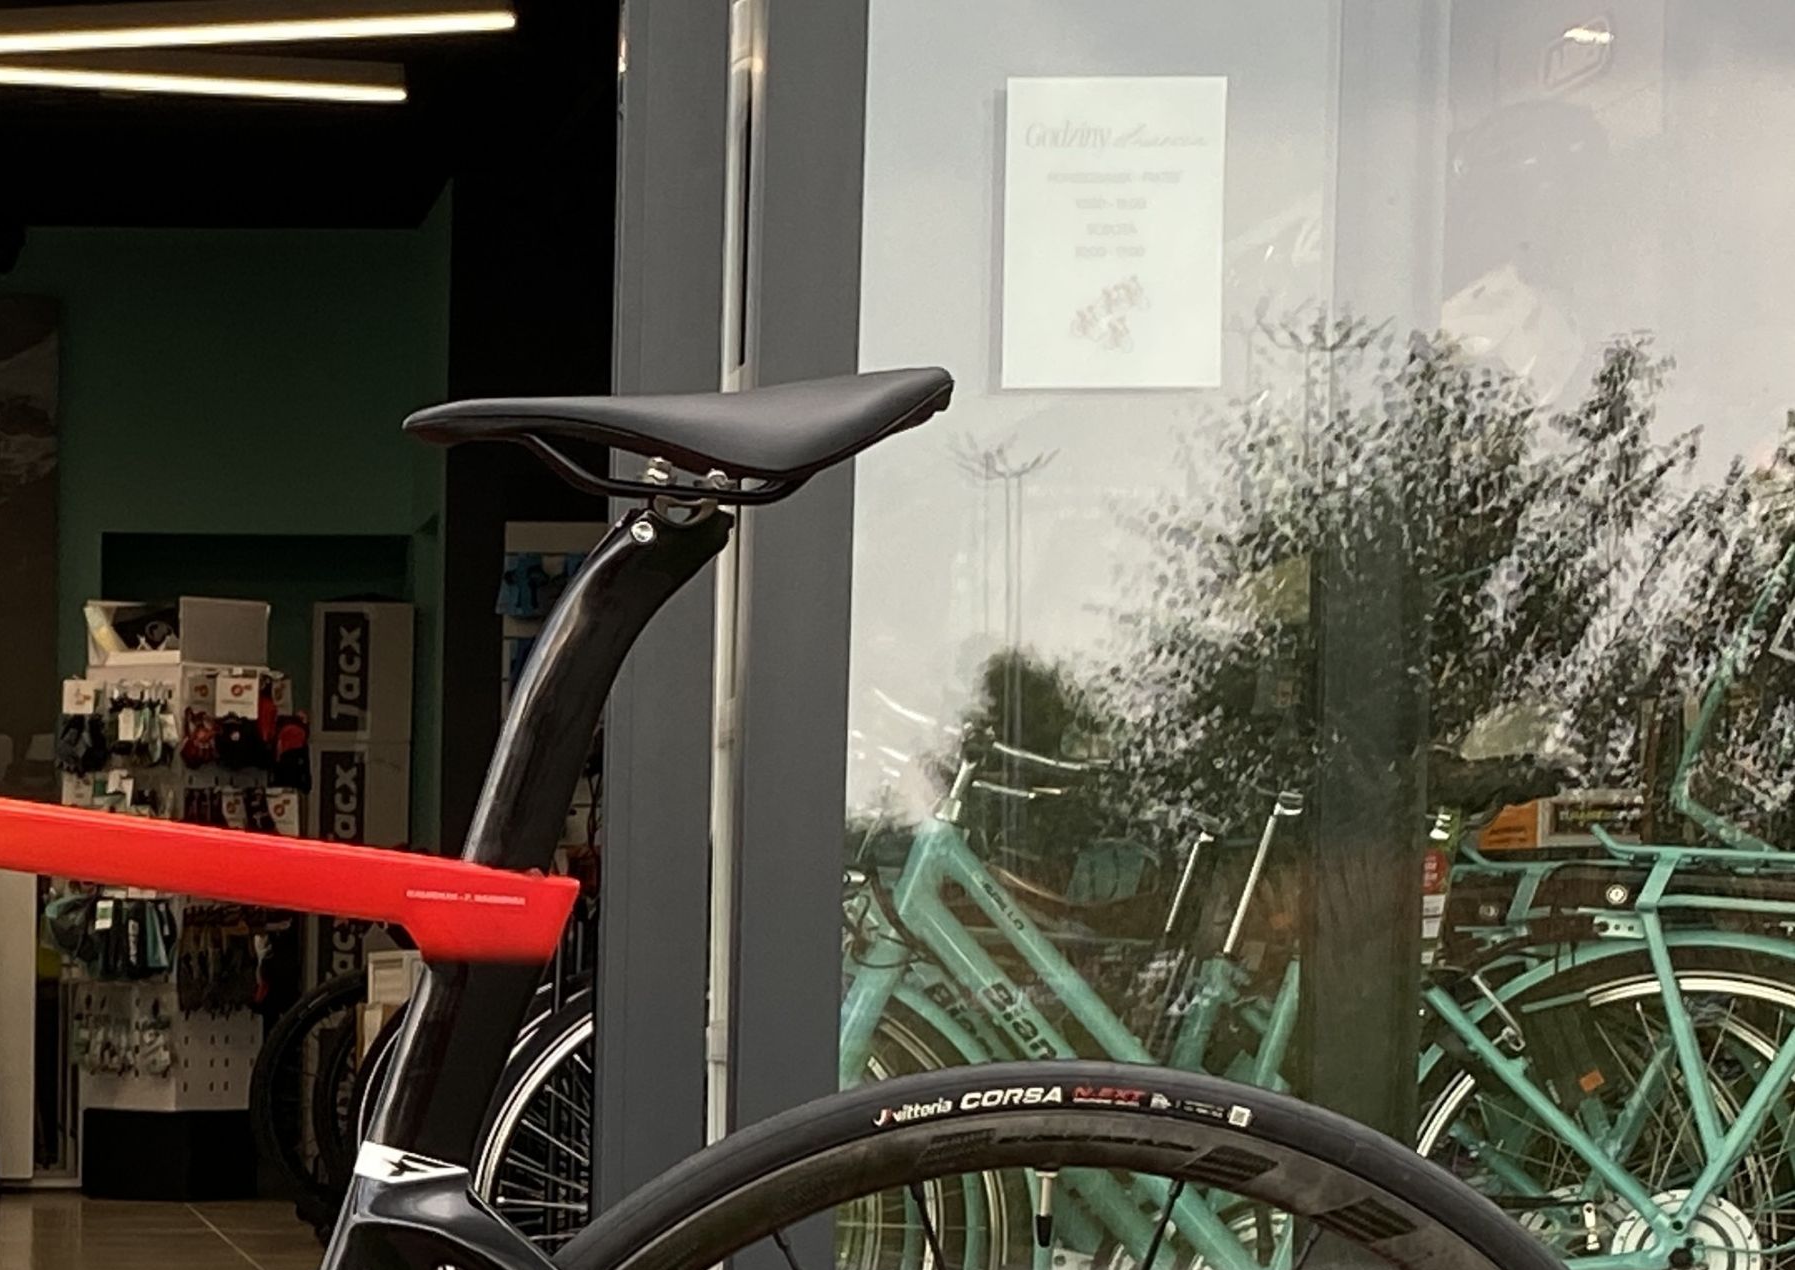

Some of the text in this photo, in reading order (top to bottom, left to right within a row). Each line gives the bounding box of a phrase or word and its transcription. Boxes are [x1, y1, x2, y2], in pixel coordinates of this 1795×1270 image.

[331, 625, 361, 721] Tacx
[328, 763, 358, 841] acx
[892, 1096, 953, 1121] vittoria
[959, 1086, 1063, 1111] CORSA
